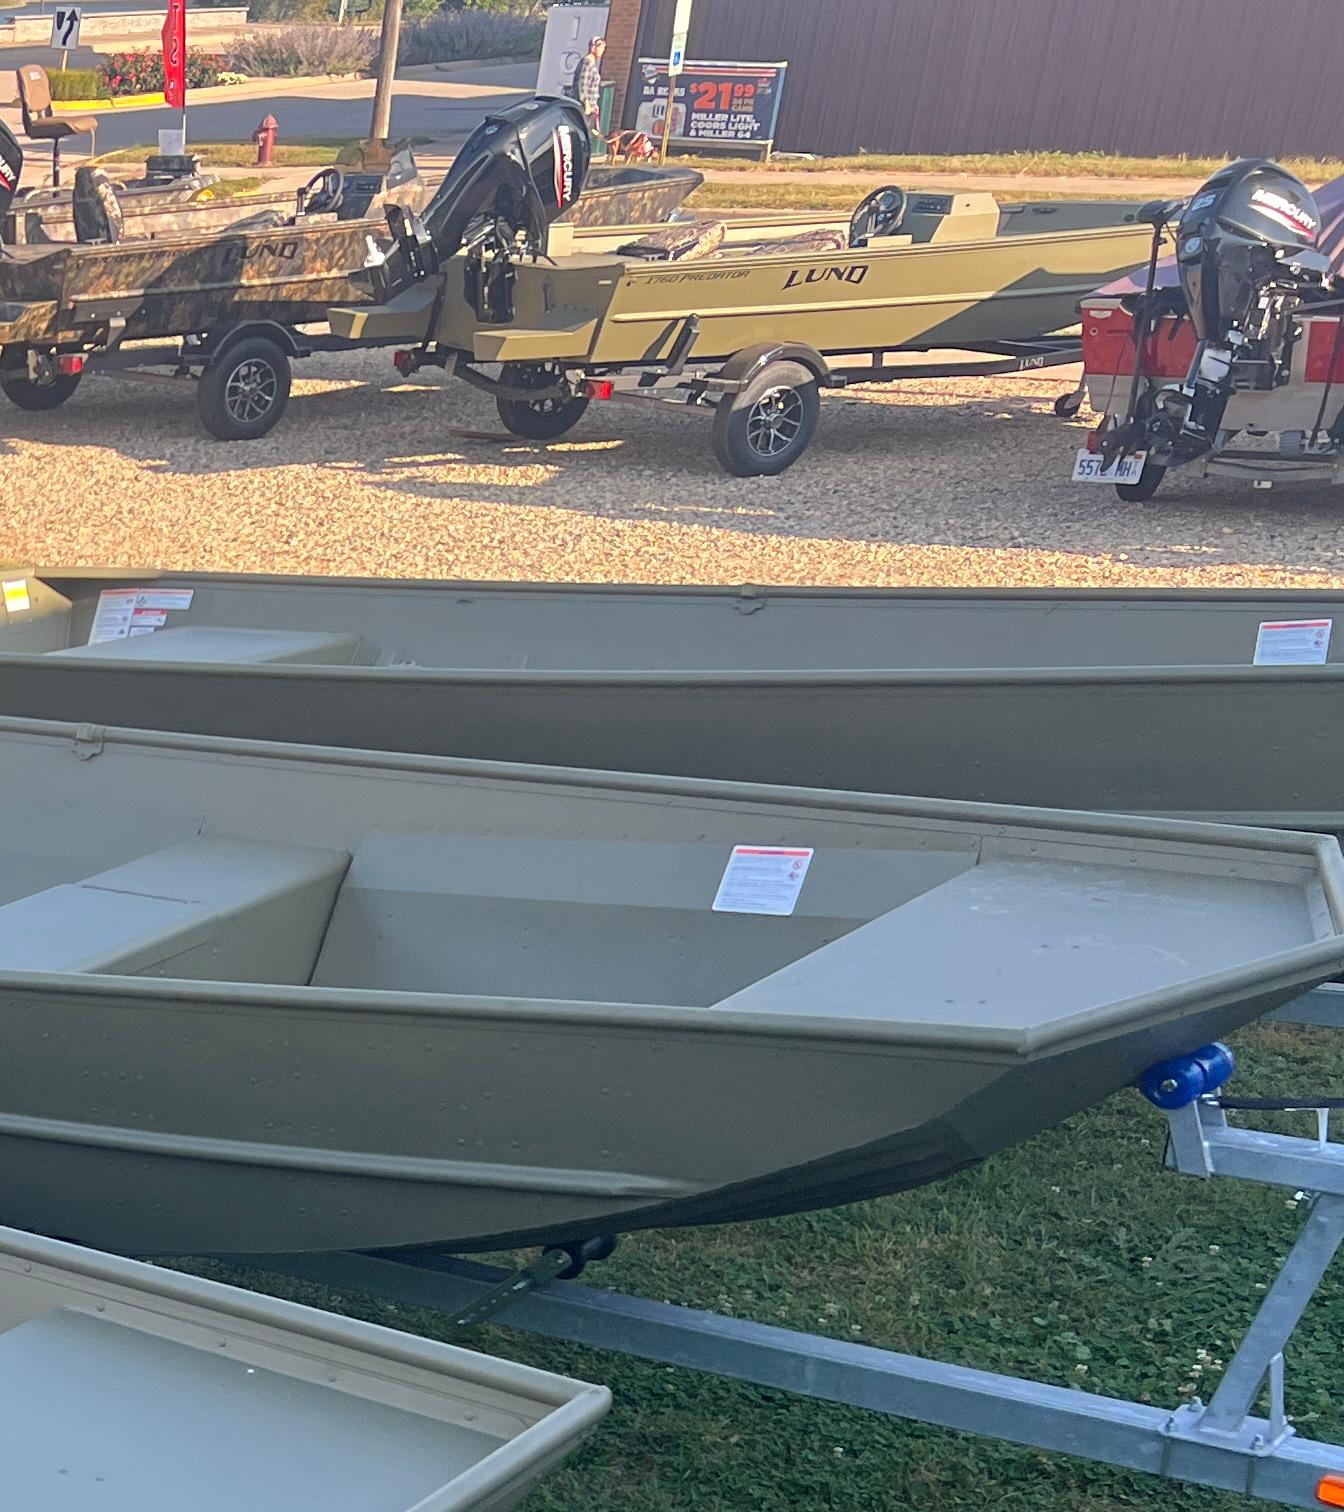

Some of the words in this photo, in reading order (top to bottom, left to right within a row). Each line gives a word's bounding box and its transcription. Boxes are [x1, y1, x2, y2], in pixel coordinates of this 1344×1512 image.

[691, 112, 729, 121] MILLER
[691, 121, 726, 130] COORS
[728, 122, 761, 131] LIGHT
[699, 130, 736, 138] MILLER
[737, 131, 752, 139] 64
[558, 126, 573, 201] MERCURY
[1191, 194, 1217, 211] 25
[1251, 189, 1317, 230] MERCURY
[679, 270, 751, 284] PREDATOR
[780, 265, 869, 291] LUND
